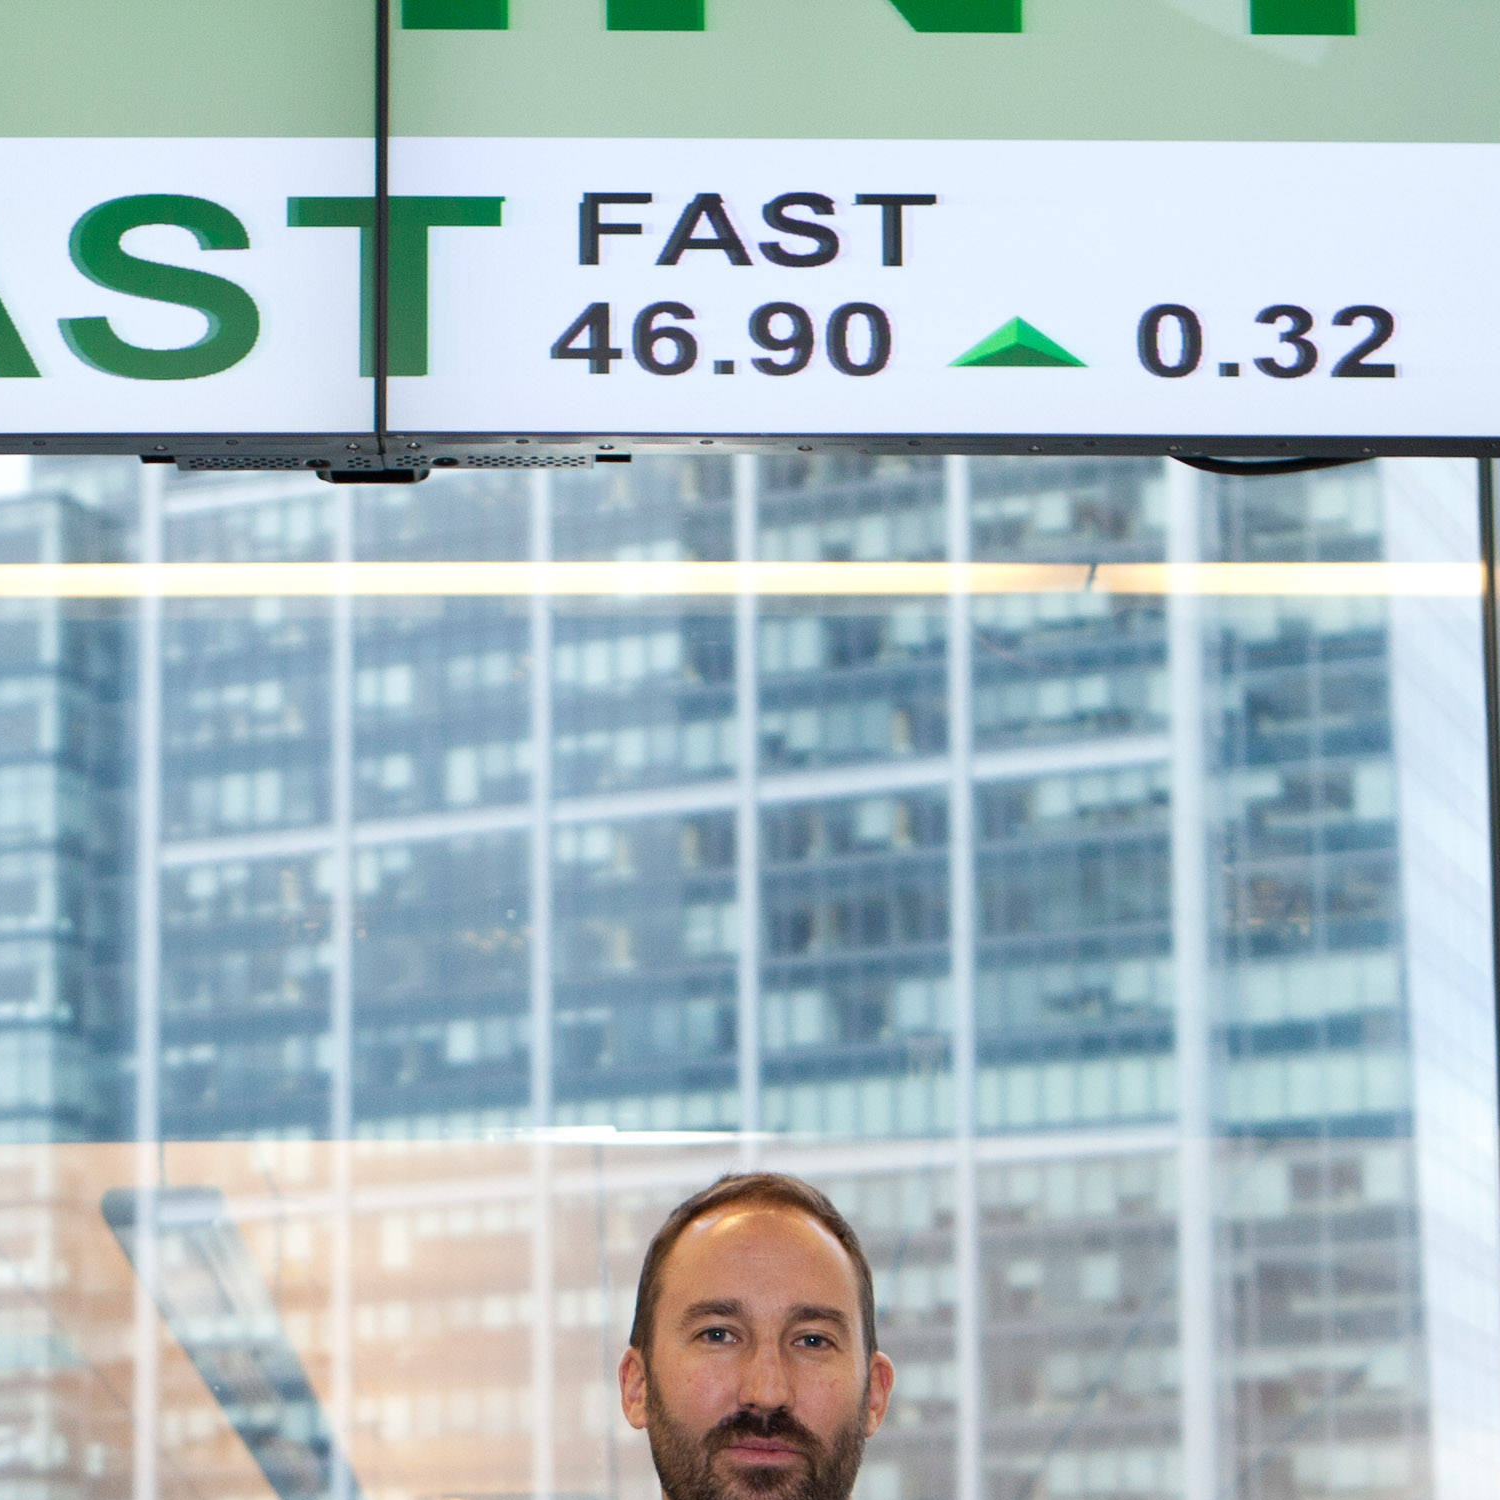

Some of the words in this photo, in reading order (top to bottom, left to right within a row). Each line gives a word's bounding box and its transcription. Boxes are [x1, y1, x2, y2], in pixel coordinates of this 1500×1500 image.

[578, 191, 938, 268] FAST
[549, 300, 894, 377] 46.90
[1135, 303, 1398, 379] 0.32
